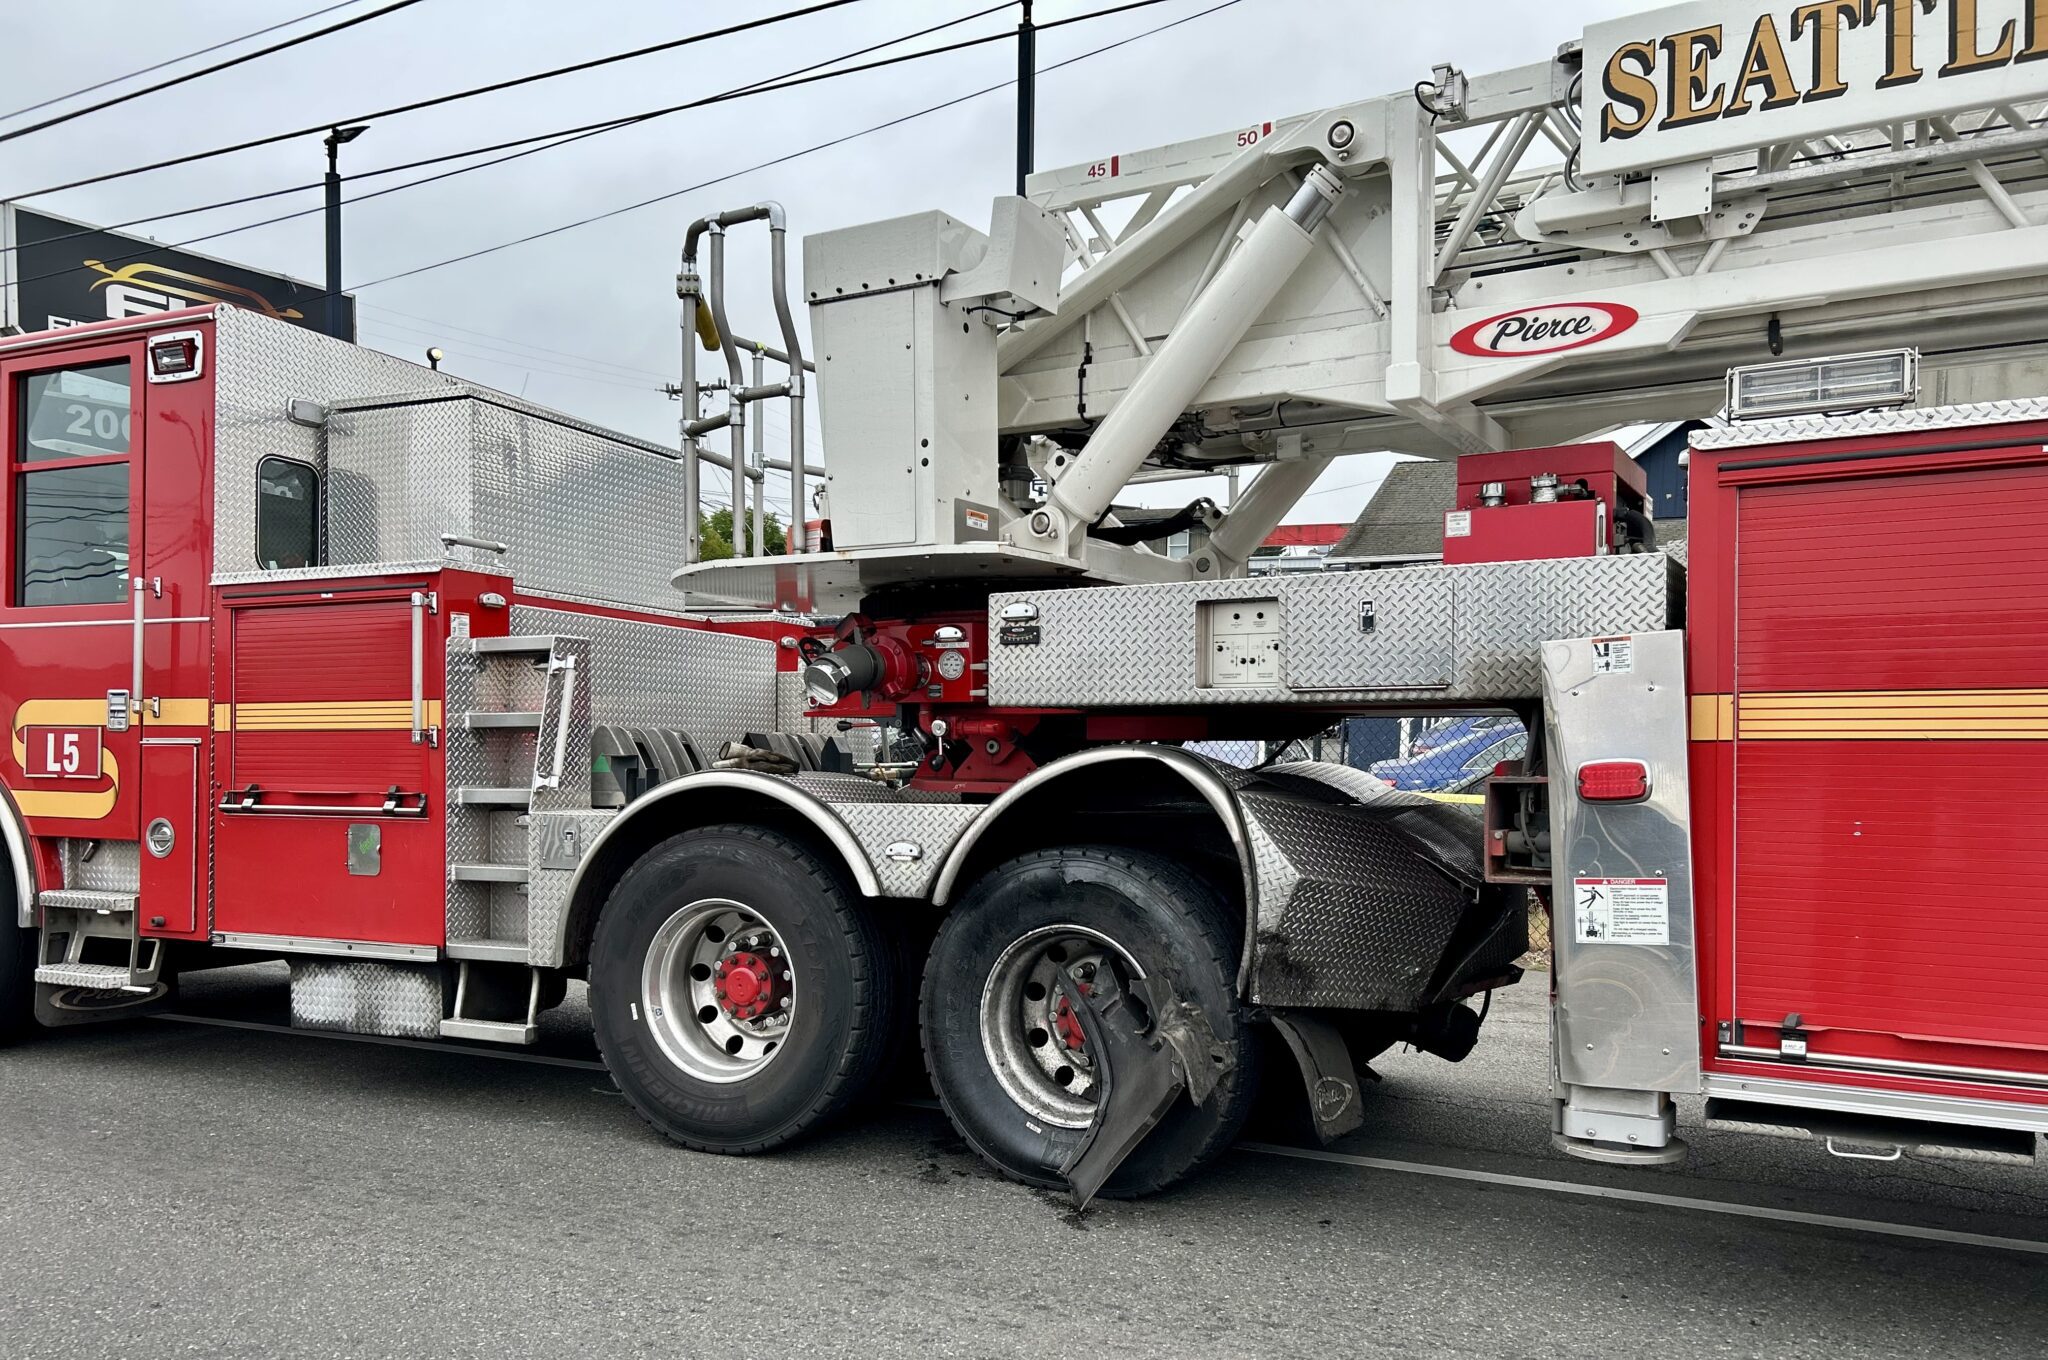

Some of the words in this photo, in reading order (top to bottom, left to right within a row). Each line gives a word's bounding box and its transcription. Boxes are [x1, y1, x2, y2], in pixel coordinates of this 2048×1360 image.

[1600, 0, 2048, 142] SEATTL
[1236, 130, 1258, 147] 50
[1087, 162, 1107, 178] 45
[1489, 315, 1593, 351] Pierce
[65, 404, 130, 442] 20
[46, 732, 80, 773] L5
[620, 1043, 730, 1122] MICHELIN
